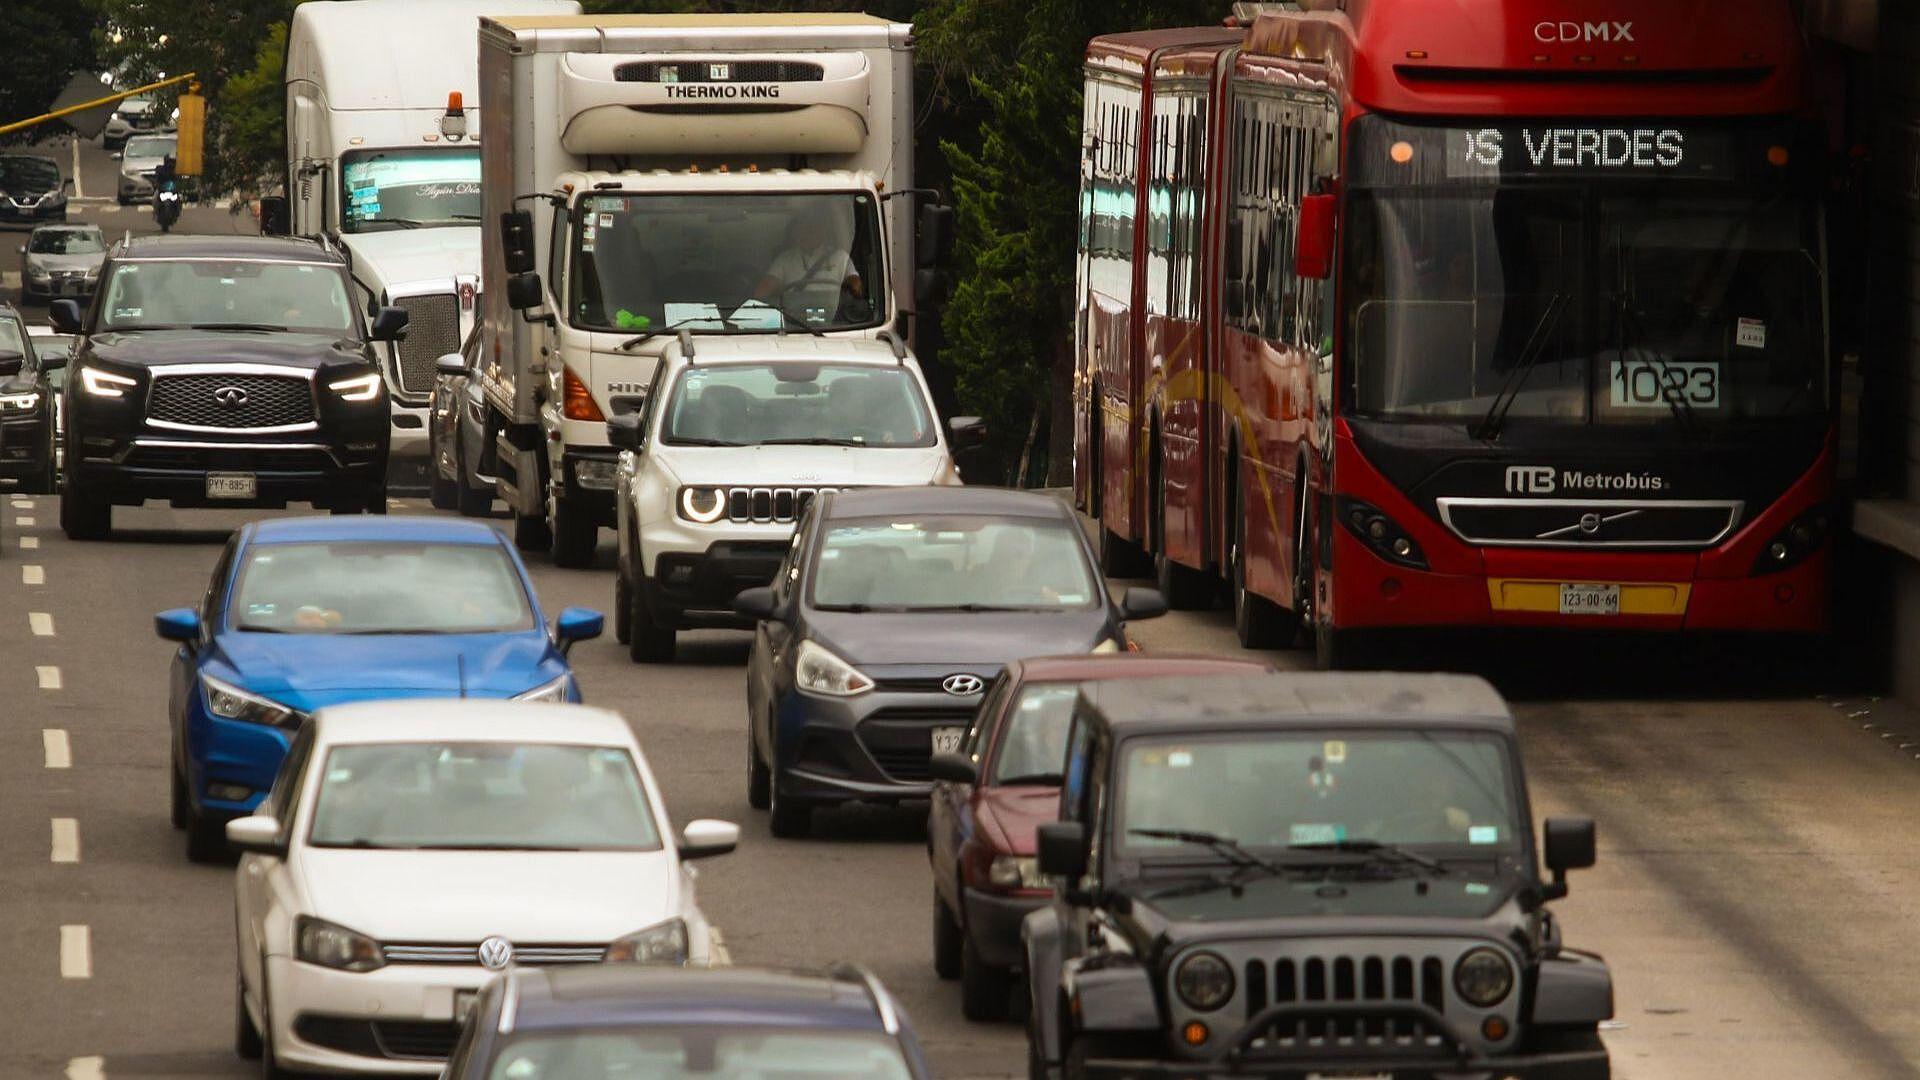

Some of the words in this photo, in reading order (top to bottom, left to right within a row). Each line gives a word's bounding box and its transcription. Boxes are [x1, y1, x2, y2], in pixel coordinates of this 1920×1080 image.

[1534, 21, 1635, 42] CDMX
[665, 85, 736, 98] THERMO
[740, 85, 779, 98] KING
[1465, 128, 1503, 166] S
[1523, 128, 1683, 166] VERDES
[1615, 366, 1716, 403] 1023
[1563, 471, 1663, 490] Metrobús
